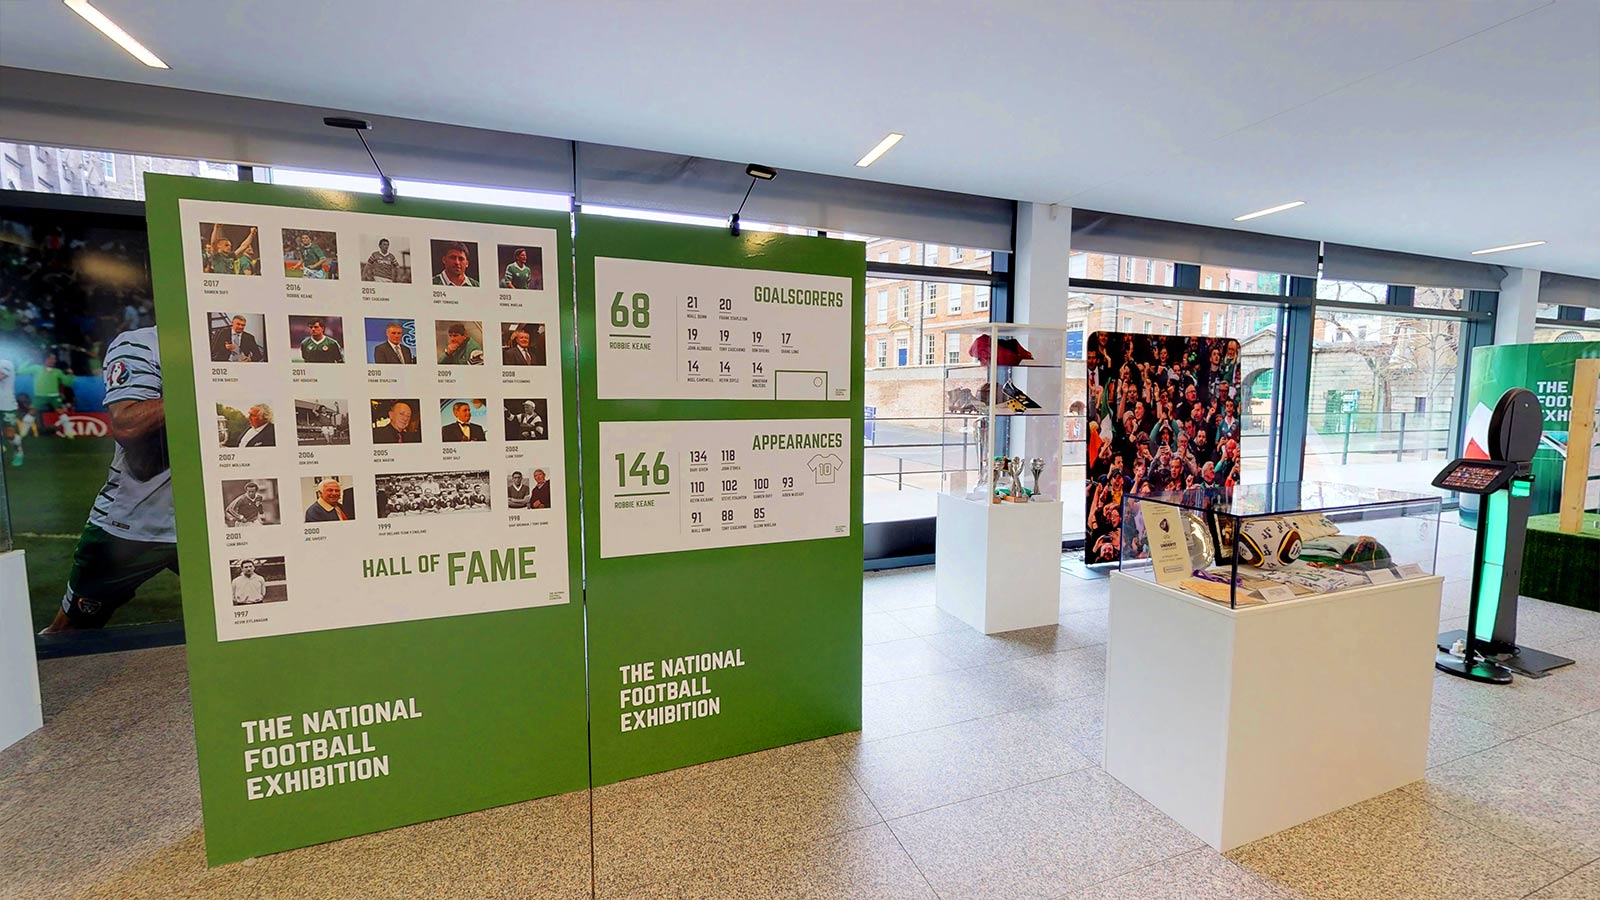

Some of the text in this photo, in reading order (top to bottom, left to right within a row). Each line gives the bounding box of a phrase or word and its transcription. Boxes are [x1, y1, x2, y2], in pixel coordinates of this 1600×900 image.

[687, 296, 698, 309] 21
[754, 286, 843, 307] GOALSCORERS
[610, 292, 650, 329] 68
[719, 298, 732, 311] 20
[687, 328, 698, 341] 19
[719, 330, 730, 343] 19
[752, 331, 762, 344] 19
[781, 333, 791, 345] 17
[609, 342, 651, 351] ROBBIE KEANE
[687, 360, 699, 373] 14
[719, 361, 731, 373] 14
[752, 362, 763, 374] 14
[1537, 381, 1568, 393] THE
[752, 433, 842, 450] APPEARANCES
[690, 450, 707, 462] 134
[721, 450, 735, 461] 118
[615, 451, 670, 487] 146
[819, 462, 831, 476] 10
[691, 482, 705, 493] 110
[722, 480, 738, 491] 102
[754, 478, 769, 490] 100
[782, 477, 794, 489] 93
[614, 500, 655, 509] ROBBIE KEANE
[691, 512, 702, 524] 91
[721, 510, 734, 521] 88
[754, 508, 765, 519] 85
[363, 546, 537, 586] HALL OF FAME
[619, 648, 745, 684] THE NATIONAL
[620, 677, 711, 709] FOOTBALL
[241, 697, 423, 744] THE NATIONAL
[621, 697, 720, 732] EXHIBITION
[244, 731, 376, 772] FOOTBALL
[247, 755, 389, 801] EXHIBITION
